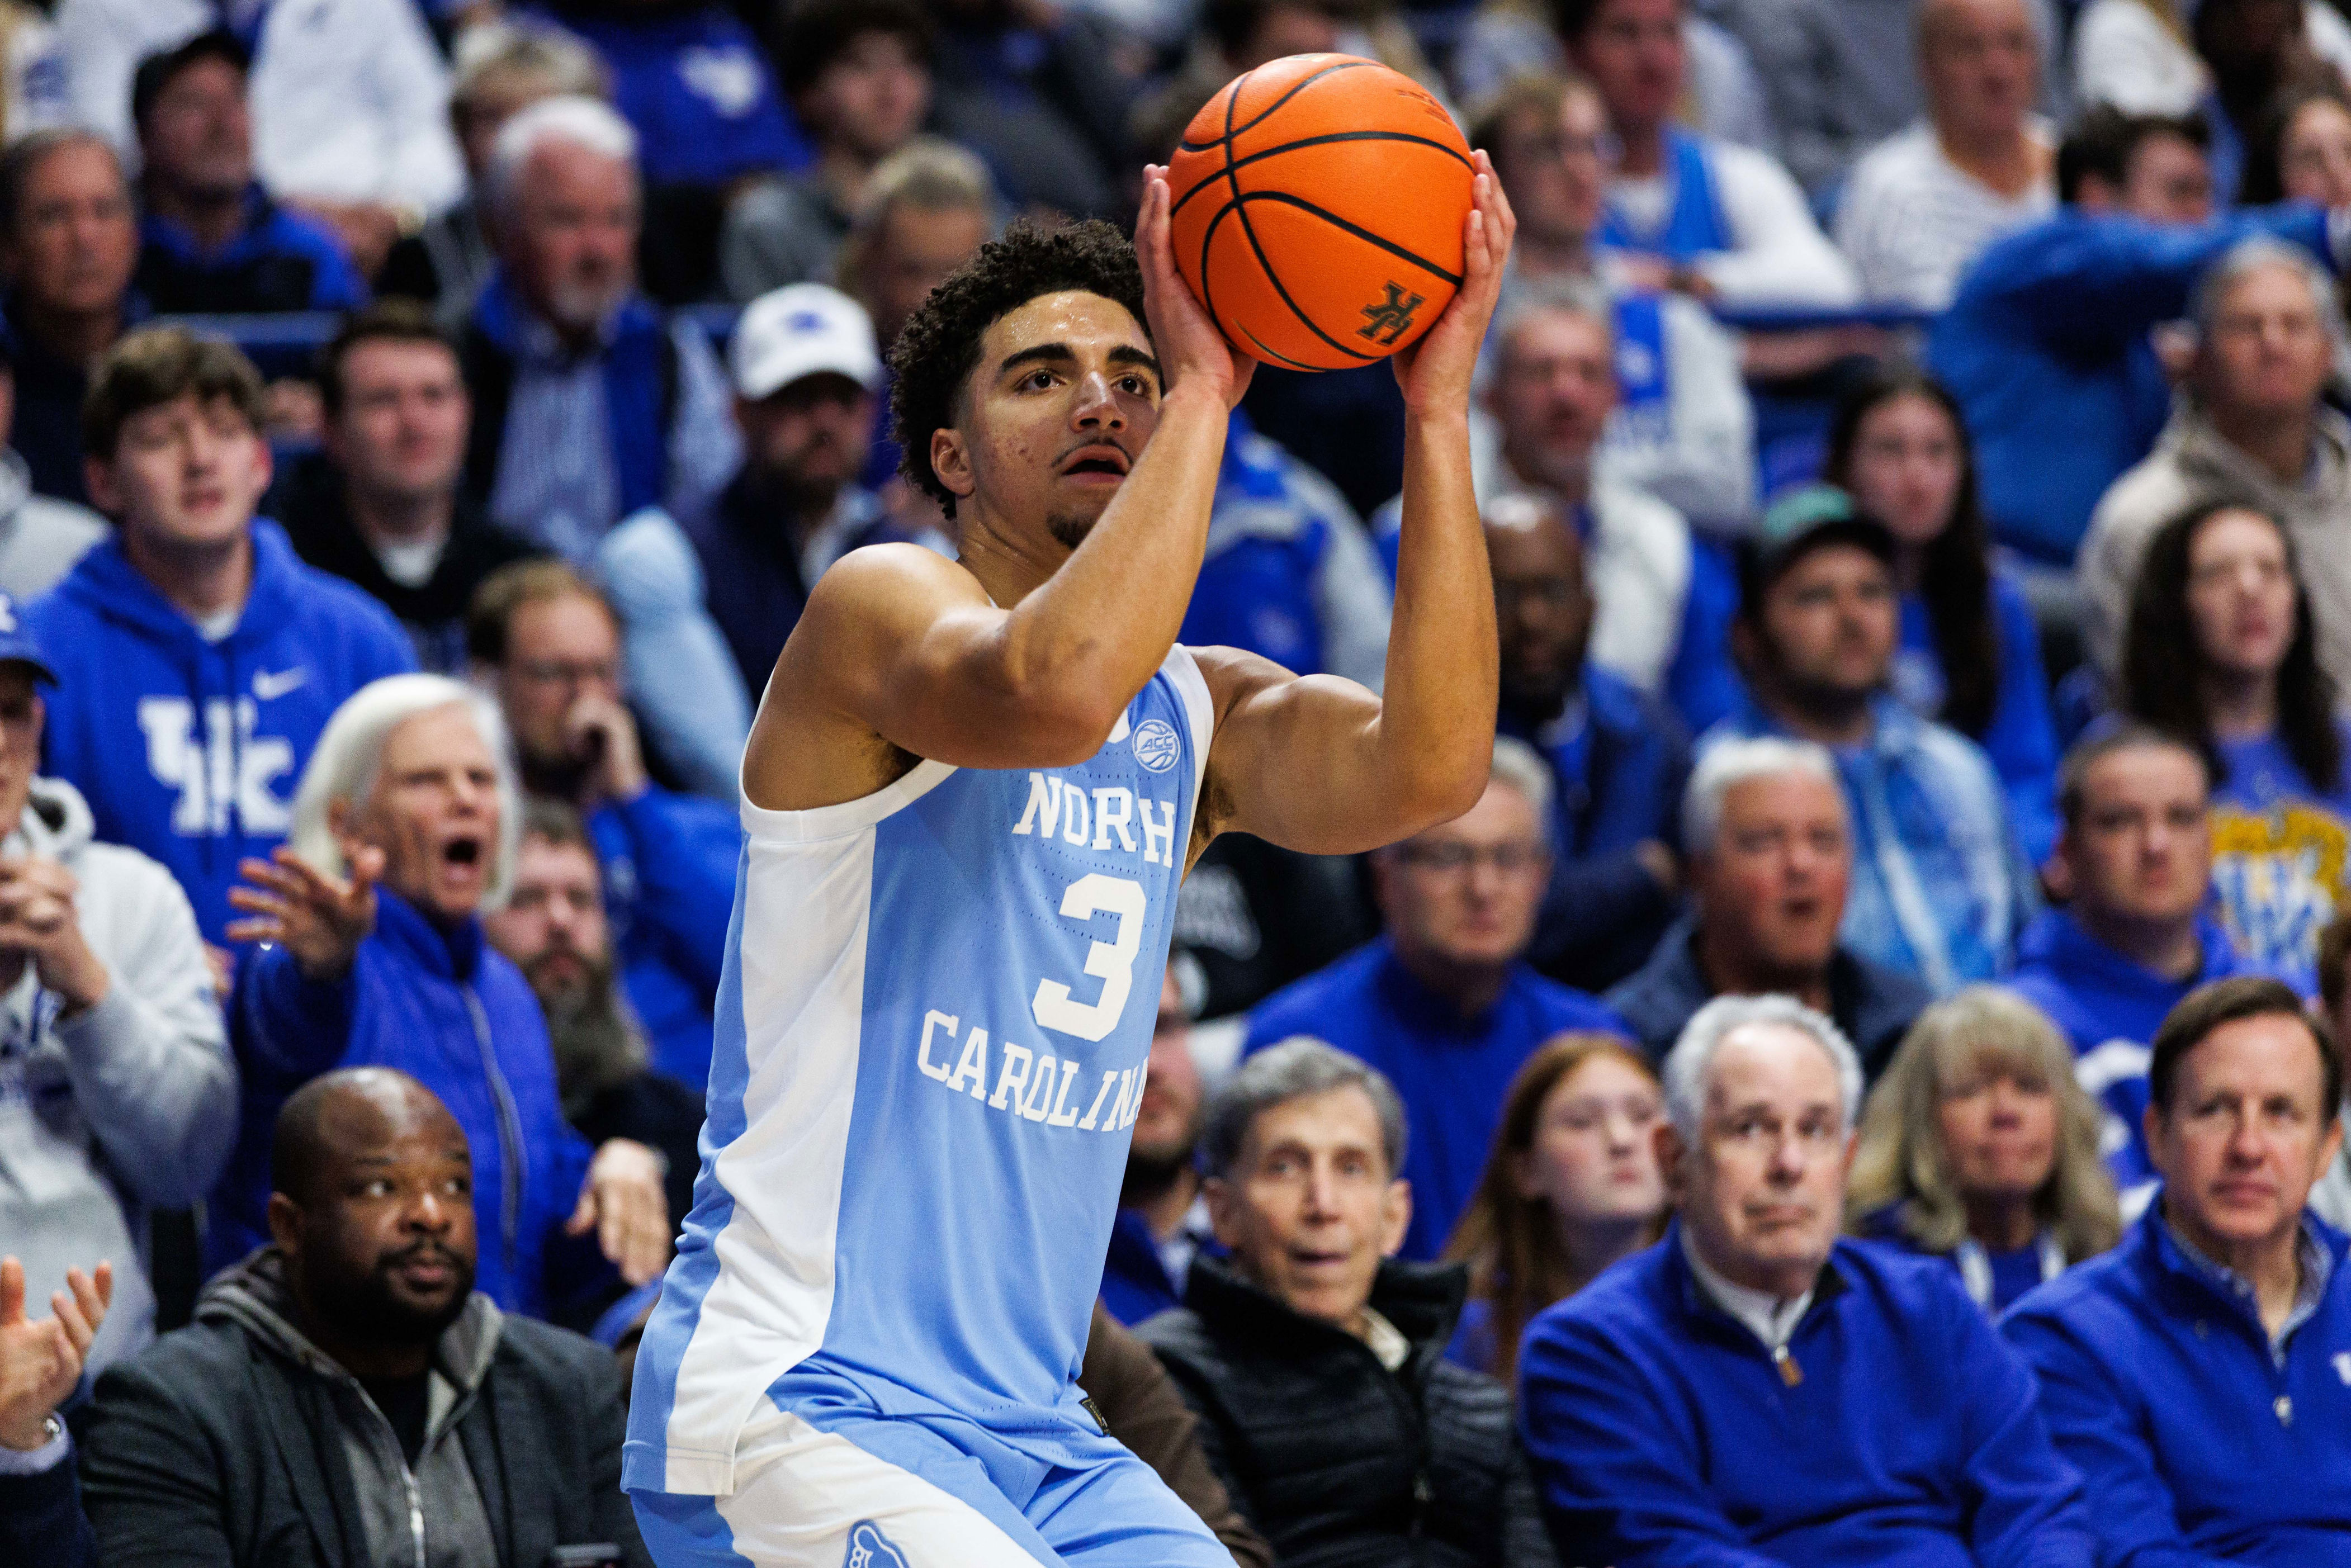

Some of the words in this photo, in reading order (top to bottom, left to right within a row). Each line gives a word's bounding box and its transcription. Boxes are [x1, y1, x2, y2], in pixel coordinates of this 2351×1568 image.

[1141, 734, 1174, 750] ACC
[1011, 772, 1175, 868] NORH
[1032, 873, 1146, 1042] 3
